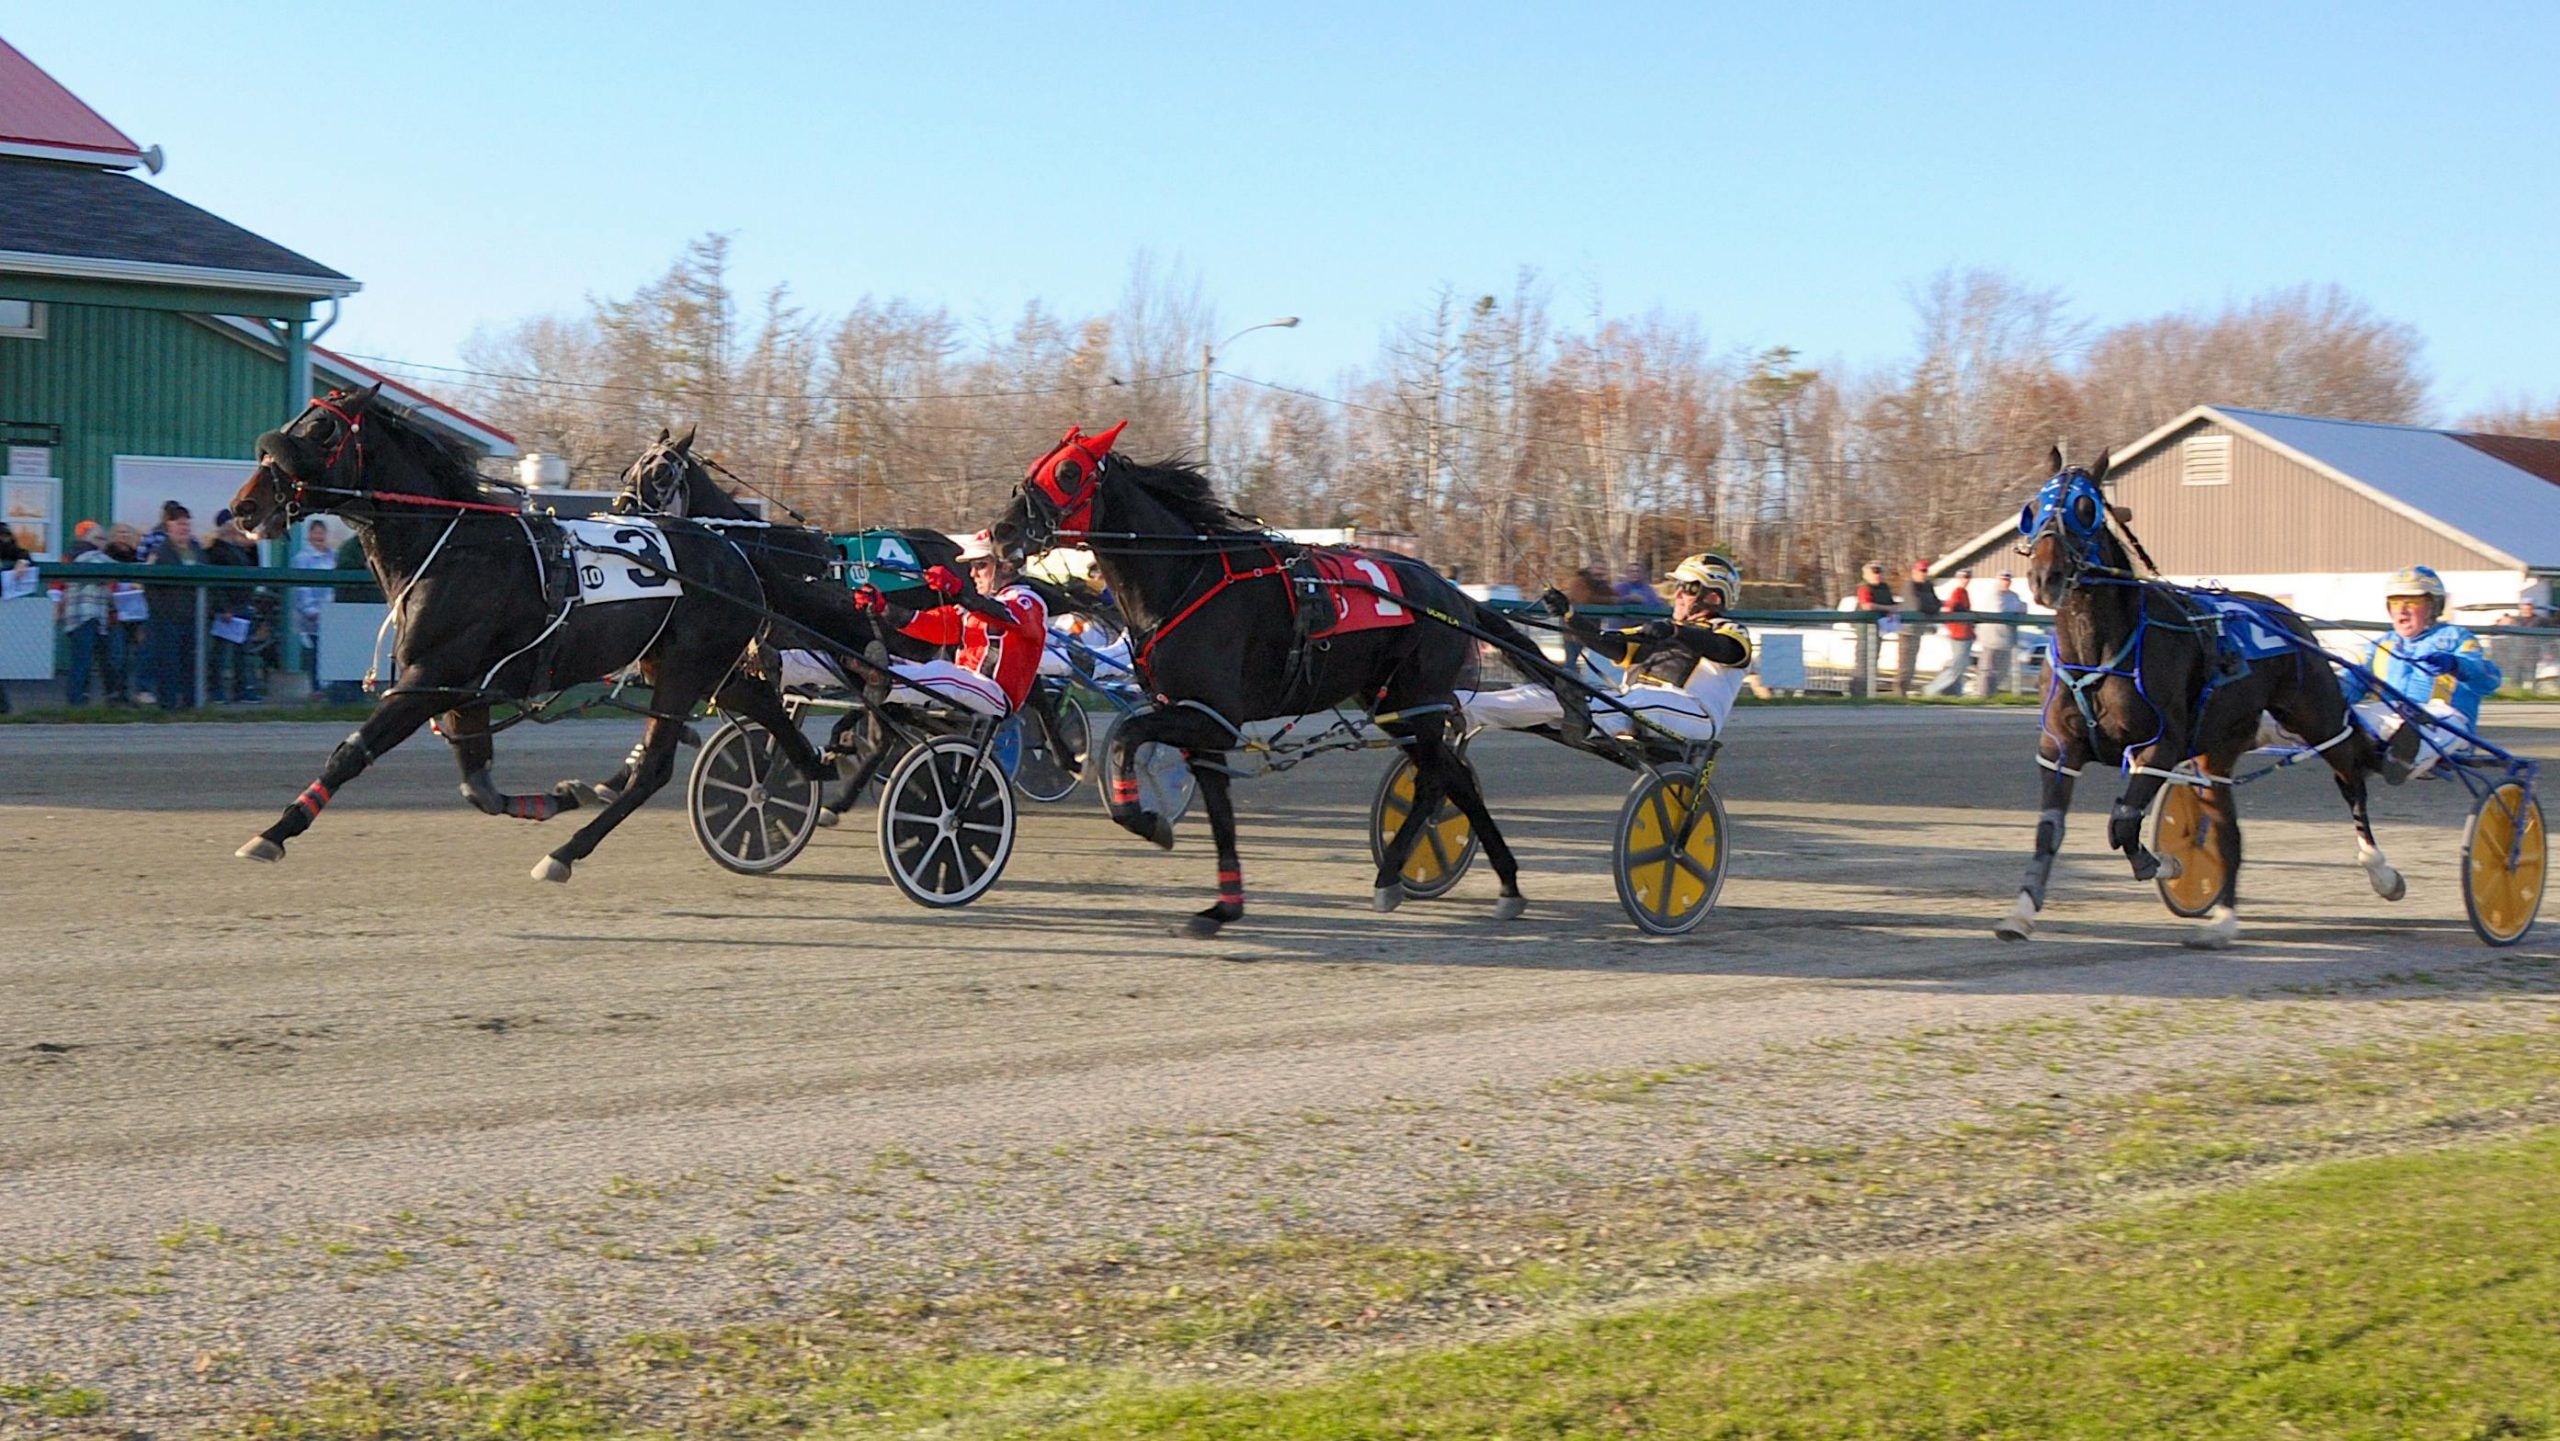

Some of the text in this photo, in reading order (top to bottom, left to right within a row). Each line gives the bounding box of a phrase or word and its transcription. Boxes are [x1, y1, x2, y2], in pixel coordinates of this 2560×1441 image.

[581, 567, 601, 586] 10
[613, 529, 669, 588] 3
[876, 538, 915, 581] 4
[1354, 558, 1404, 616] 1
[2213, 601, 2288, 650] 2
